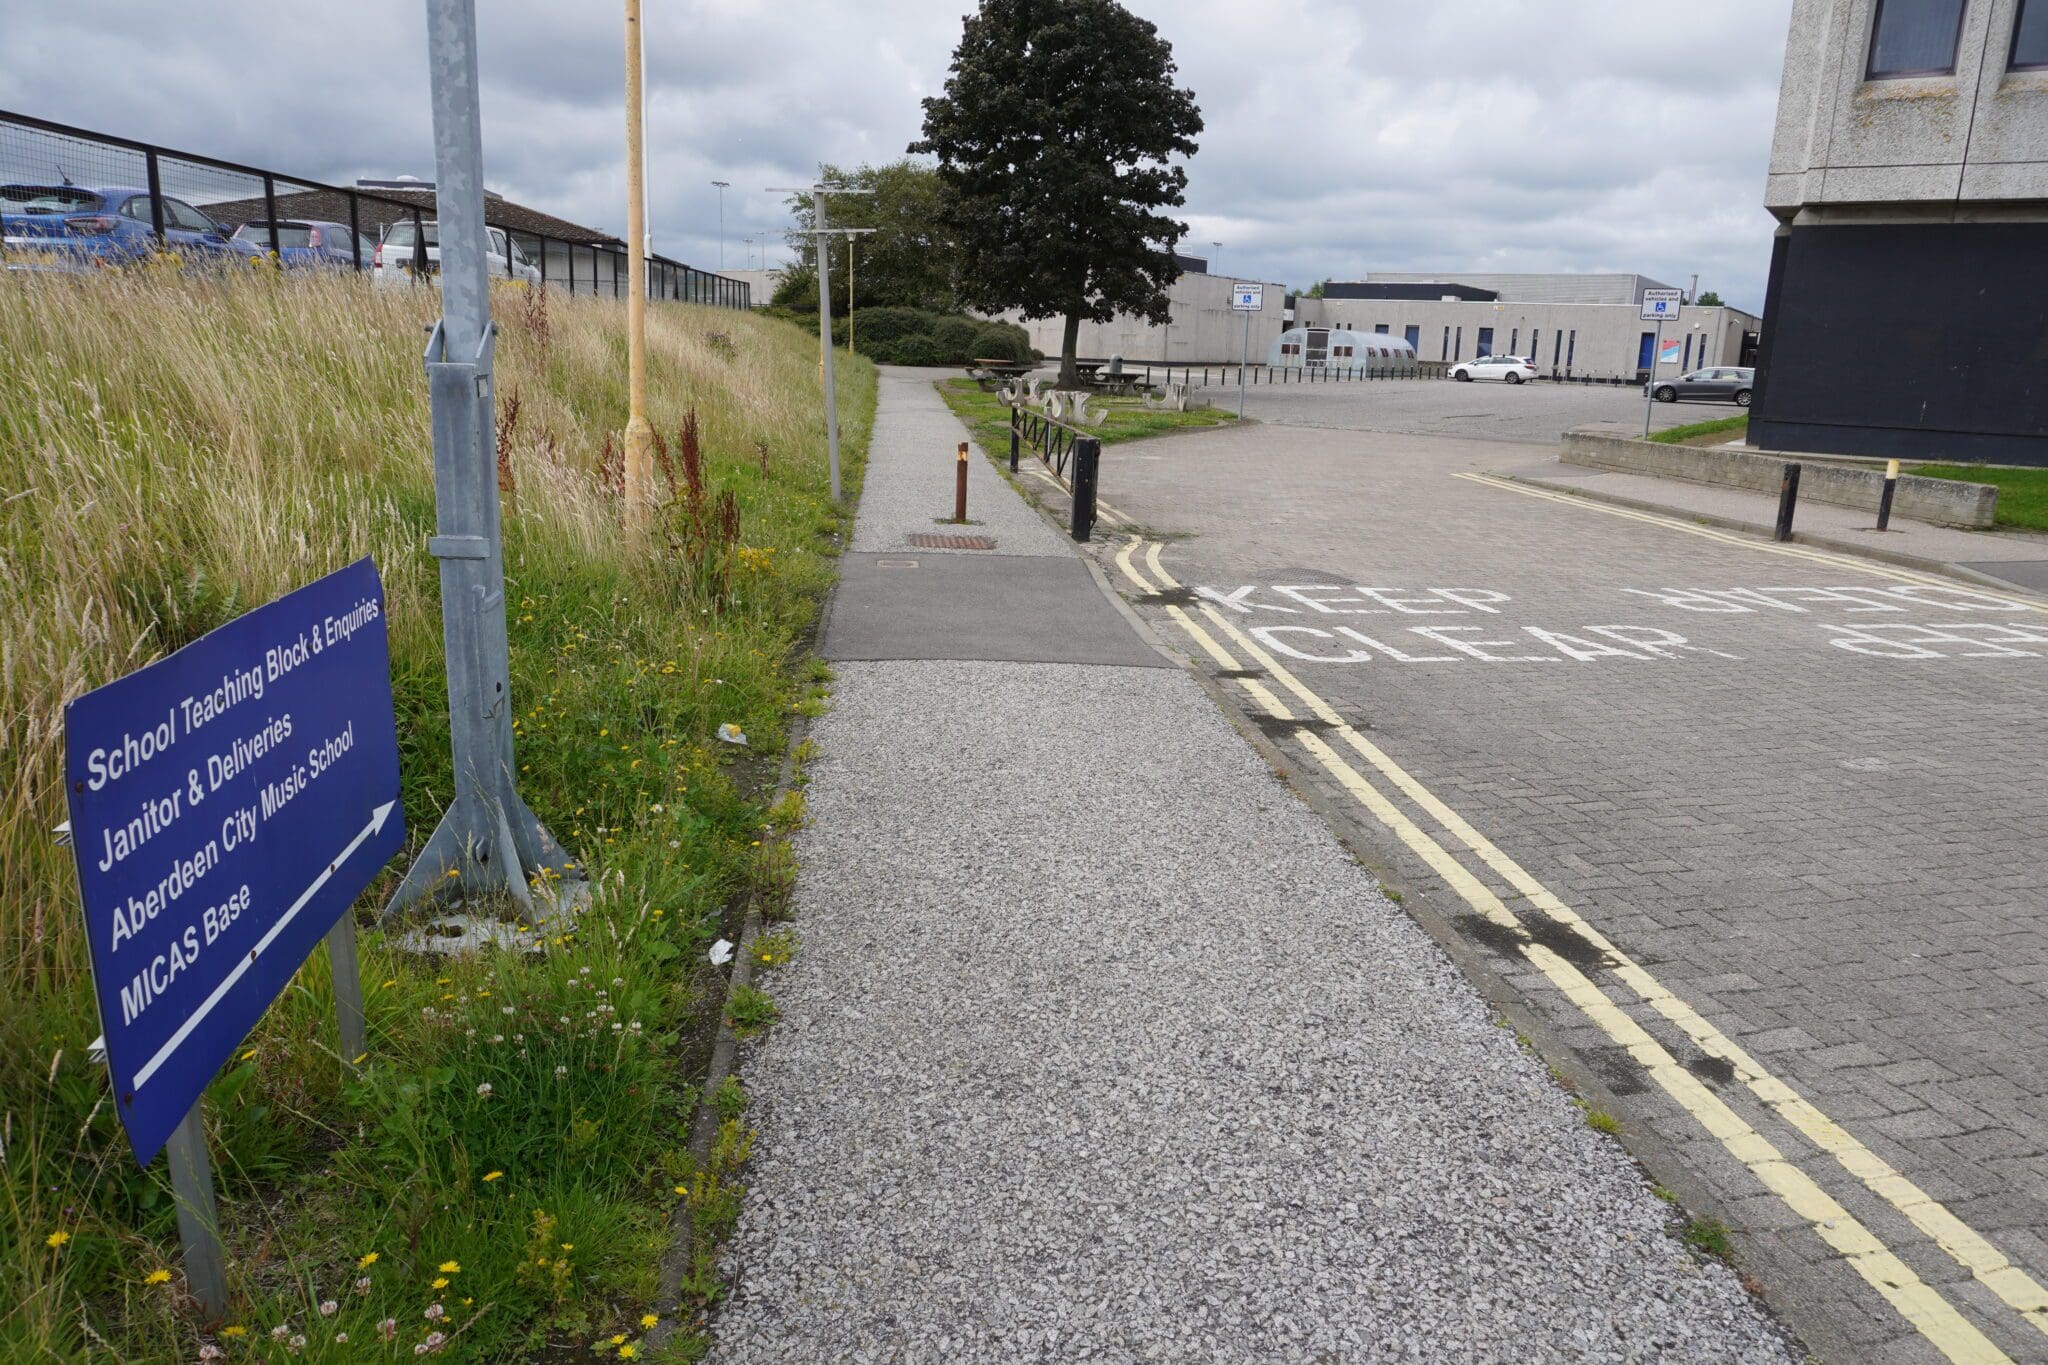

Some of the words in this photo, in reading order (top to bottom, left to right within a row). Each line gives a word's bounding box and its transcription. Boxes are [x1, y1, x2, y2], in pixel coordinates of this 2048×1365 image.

[1193, 586, 1511, 614] KEEP
[1247, 625, 1746, 664] CLEAR
[87, 708, 176, 792] School
[180, 664, 263, 735] Teaching
[266, 633, 310, 683] Block
[312, 624, 323, 655] &
[325, 598, 379, 648] Enquiries
[98, 788, 181, 873] Janitor
[188, 768, 205, 806] &
[207, 713, 292, 792] Deliveries
[112, 840, 218, 952] Aberdeen
[222, 803, 257, 850] City
[260, 764, 308, 821] Music
[309, 720, 354, 779] School
[120, 926, 199, 1027] MICAS
[203, 884, 251, 946] Base
